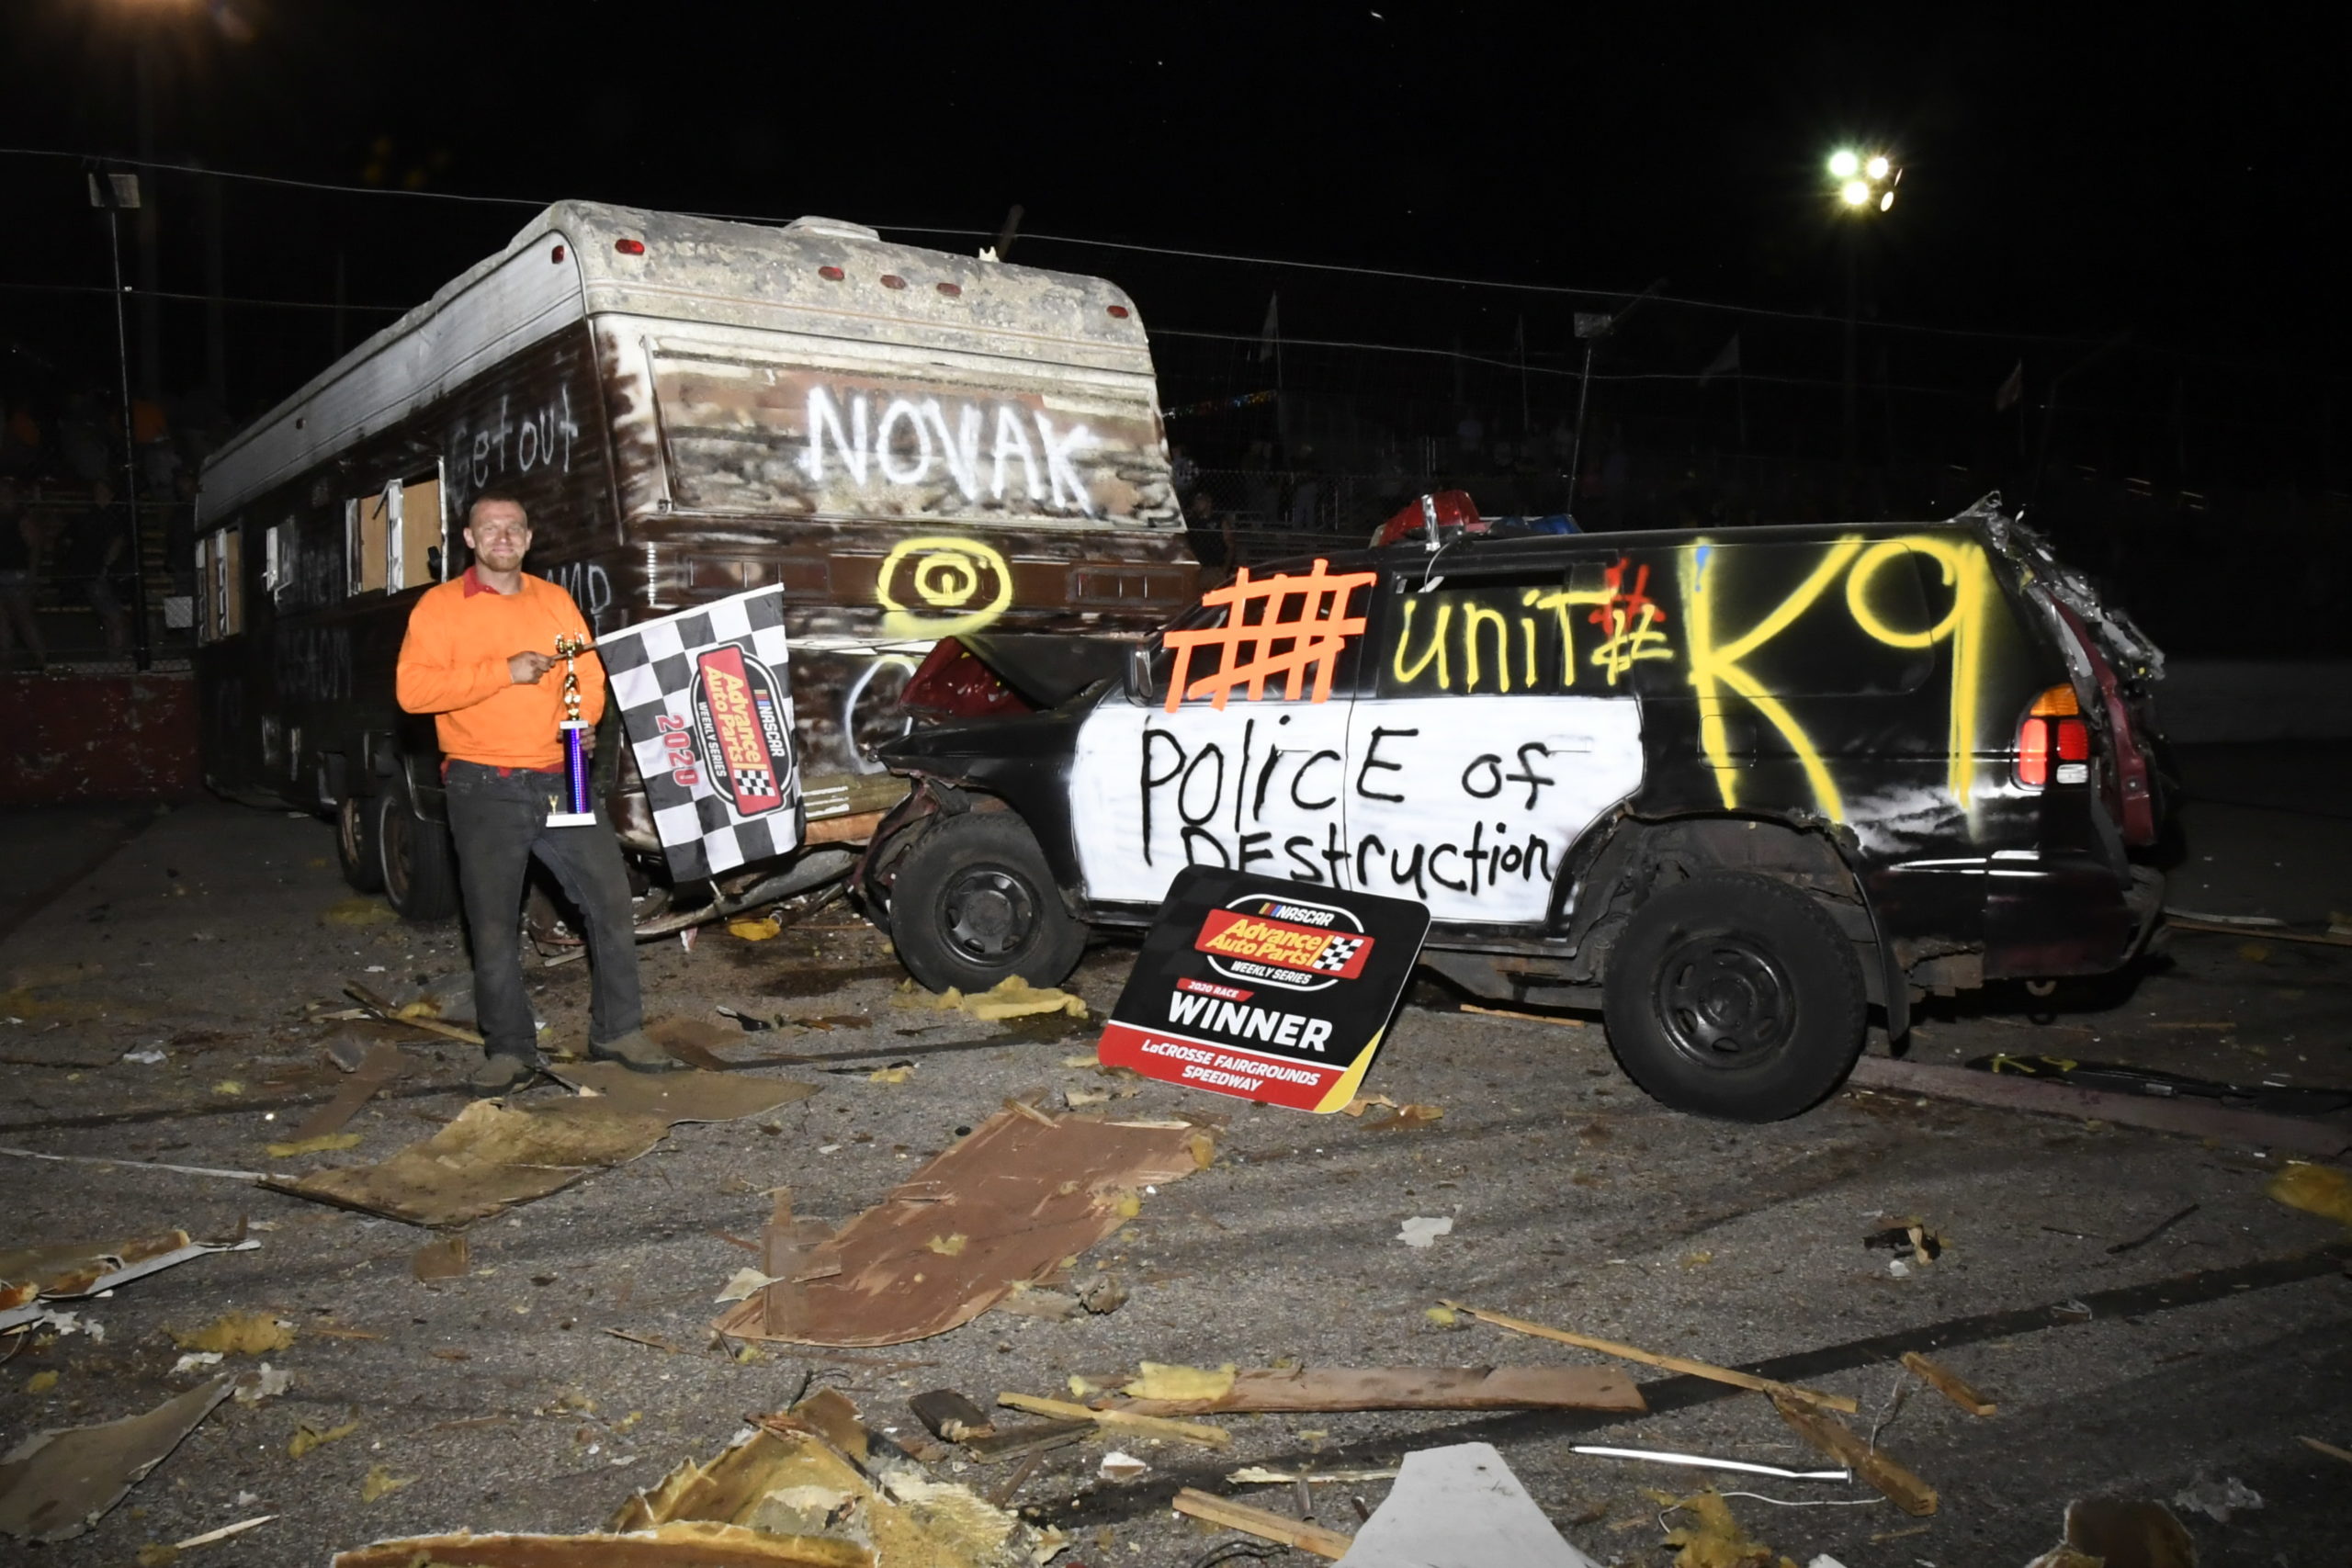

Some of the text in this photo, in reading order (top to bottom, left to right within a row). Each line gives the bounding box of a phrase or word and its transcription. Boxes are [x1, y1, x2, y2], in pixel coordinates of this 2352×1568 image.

[805, 385, 1099, 516] NOVAK
[1679, 535, 1990, 827] K9
[697, 701, 727, 778] WEEKLY SERIES
[705, 665, 743, 769] Auto Parts
[722, 671, 762, 763] Advance
[758, 705, 786, 758] NASCAR
[655, 714, 699, 787] 2020
[1225, 919, 1323, 952] Advance
[1275, 904, 1335, 927] NASCAR
[1205, 933, 1312, 966] Auto Parts
[1230, 960, 1313, 985] WEEKLY SERIES
[1187, 981, 1240, 998] 2020 RACE
[1168, 990, 1333, 1053] WINNER
[1141, 1039, 1321, 1087] LaCROSSE FAIRGROUNDS
[1182, 1065, 1264, 1092] SPEEDWAY
